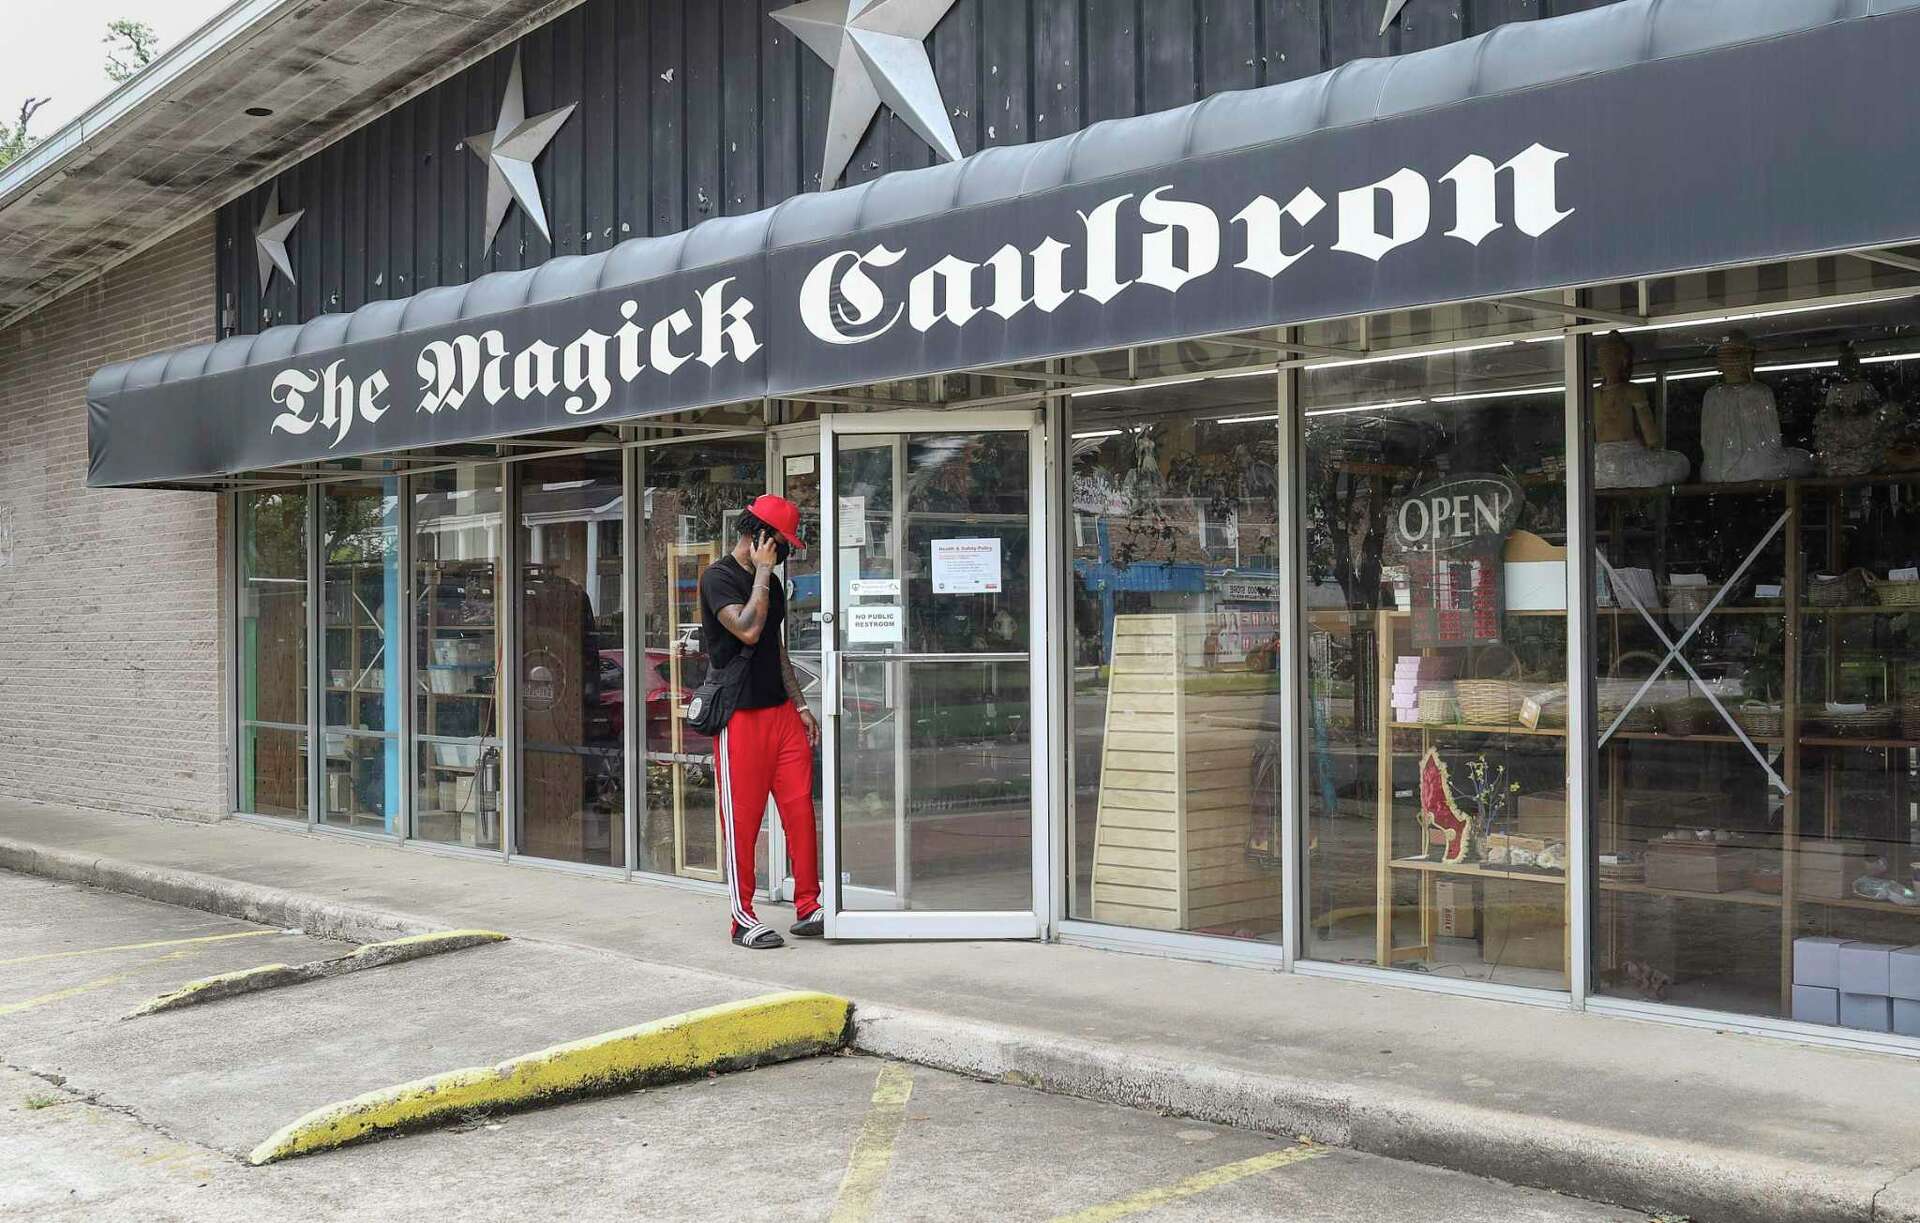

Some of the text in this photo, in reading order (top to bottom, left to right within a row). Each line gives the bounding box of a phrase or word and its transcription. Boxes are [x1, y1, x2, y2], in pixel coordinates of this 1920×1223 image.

[270, 142, 1576, 449] The Magick Cauldron
[1398, 493, 1501, 542] OPEN
